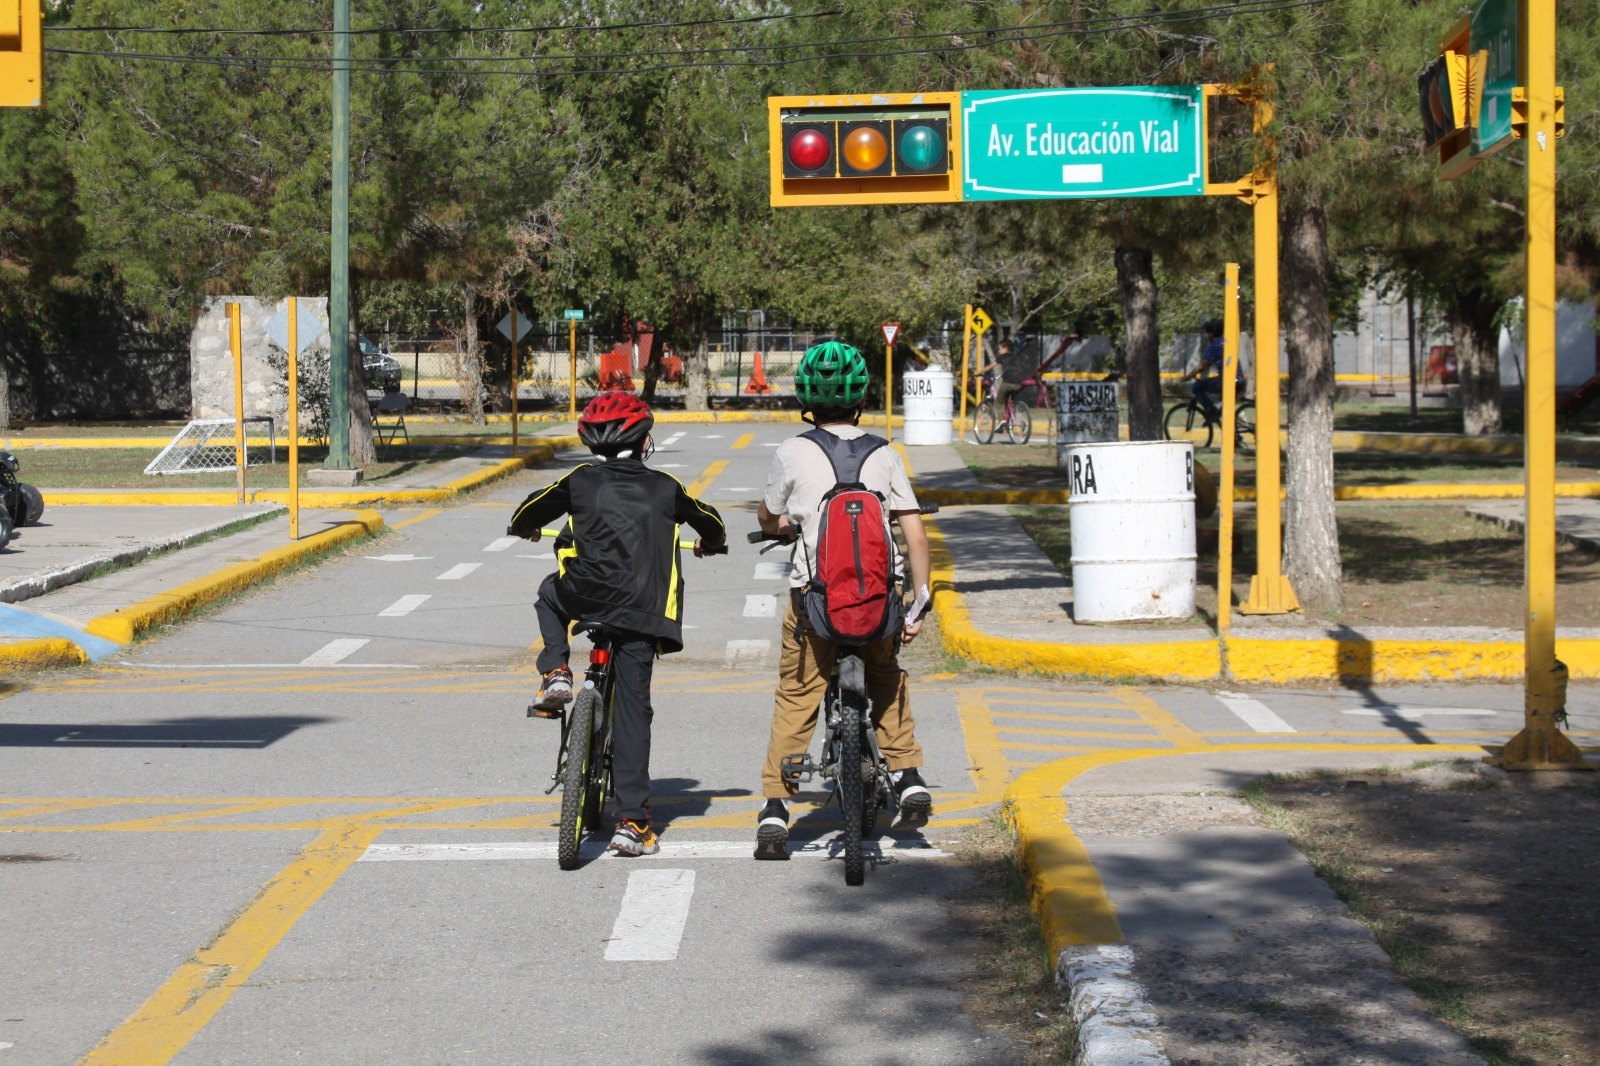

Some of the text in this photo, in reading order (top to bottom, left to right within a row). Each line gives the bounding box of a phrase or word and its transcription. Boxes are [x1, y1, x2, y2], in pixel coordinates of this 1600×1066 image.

[988, 119, 1179, 157] Av. Educación Vial
